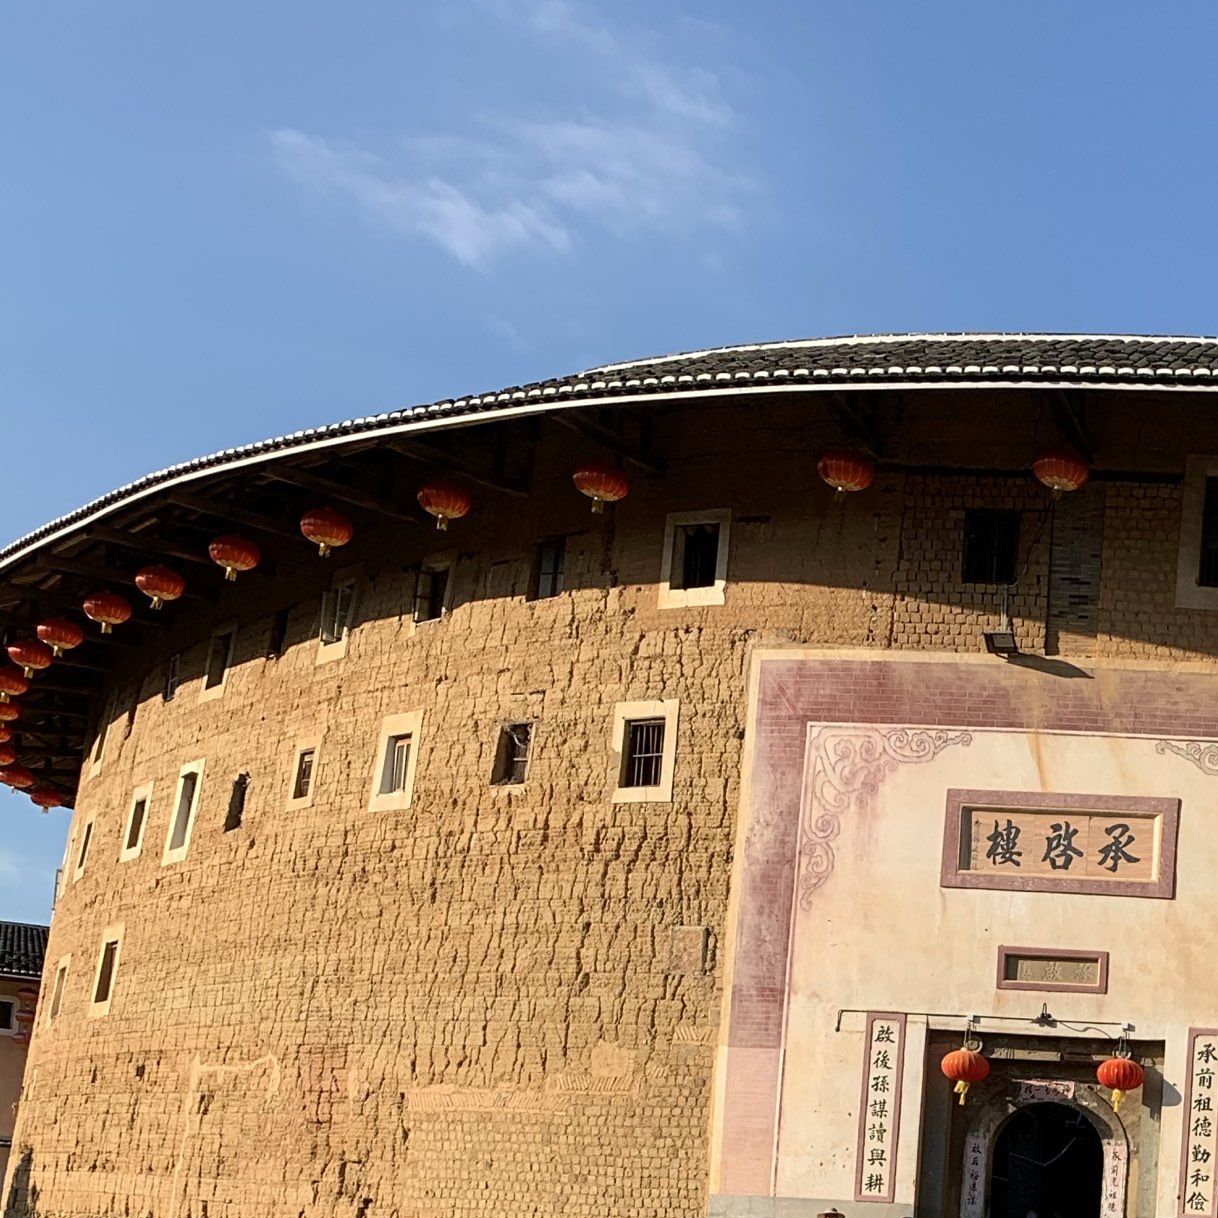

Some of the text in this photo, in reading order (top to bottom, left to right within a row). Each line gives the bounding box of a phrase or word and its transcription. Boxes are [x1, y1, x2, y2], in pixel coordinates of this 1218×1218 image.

[1186, 1043, 1218, 1211] 承前祖德勤和儉
